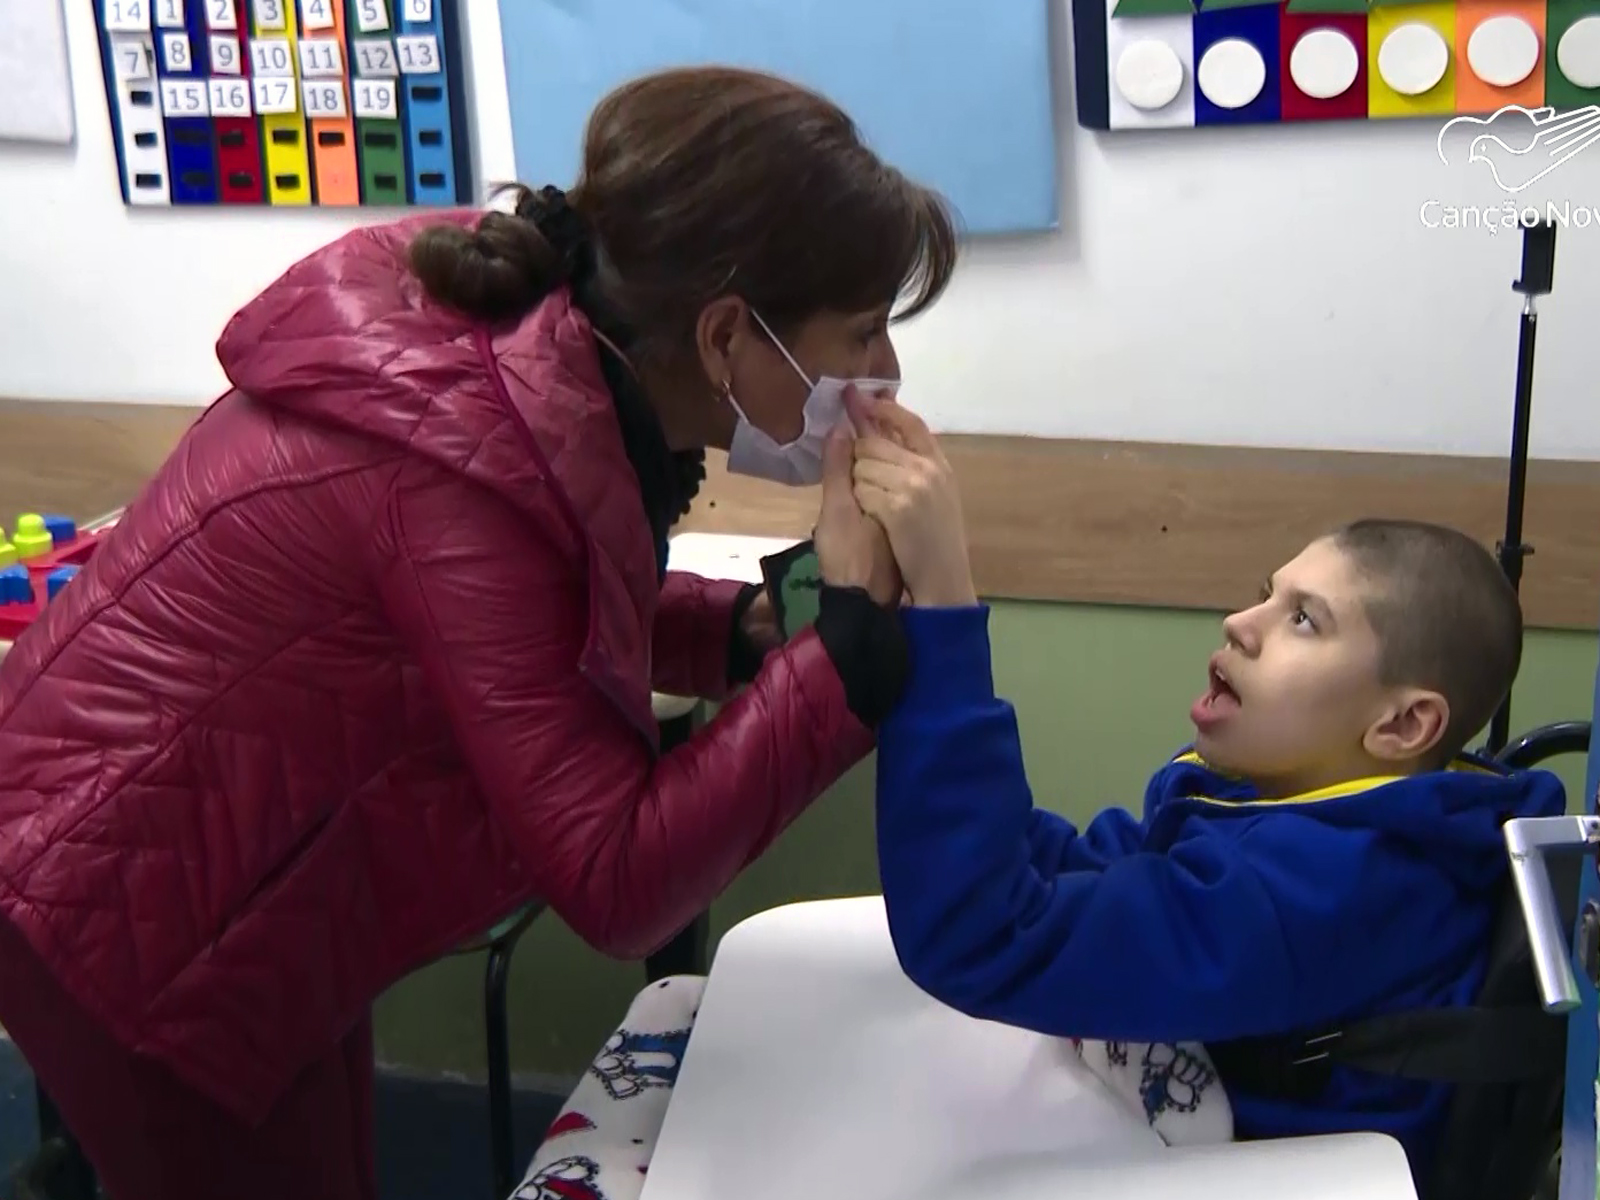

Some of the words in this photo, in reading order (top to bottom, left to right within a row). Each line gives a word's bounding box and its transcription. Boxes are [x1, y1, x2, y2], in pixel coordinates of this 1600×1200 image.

[113, 2, 141, 22] 14
[166, 0, 177, 19] 1
[215, 0, 229, 20] 2
[264, 0, 278, 20] 3
[309, 0, 325, 18] 4
[362, 0, 377, 21] 5
[413, 0, 426, 14] 6
[125, 51, 139, 73] 7
[171, 41, 185, 64] 8
[218, 45, 233, 66] 9
[257, 48, 287, 70] 10
[308, 47, 336, 69] 11
[361, 49, 391, 69] 12
[404, 45, 433, 67] 13
[169, 88, 199, 110] 15
[215, 87, 244, 108] 16
[260, 84, 288, 105] 17
[309, 89, 338, 111] 18
[363, 87, 390, 110] 19
